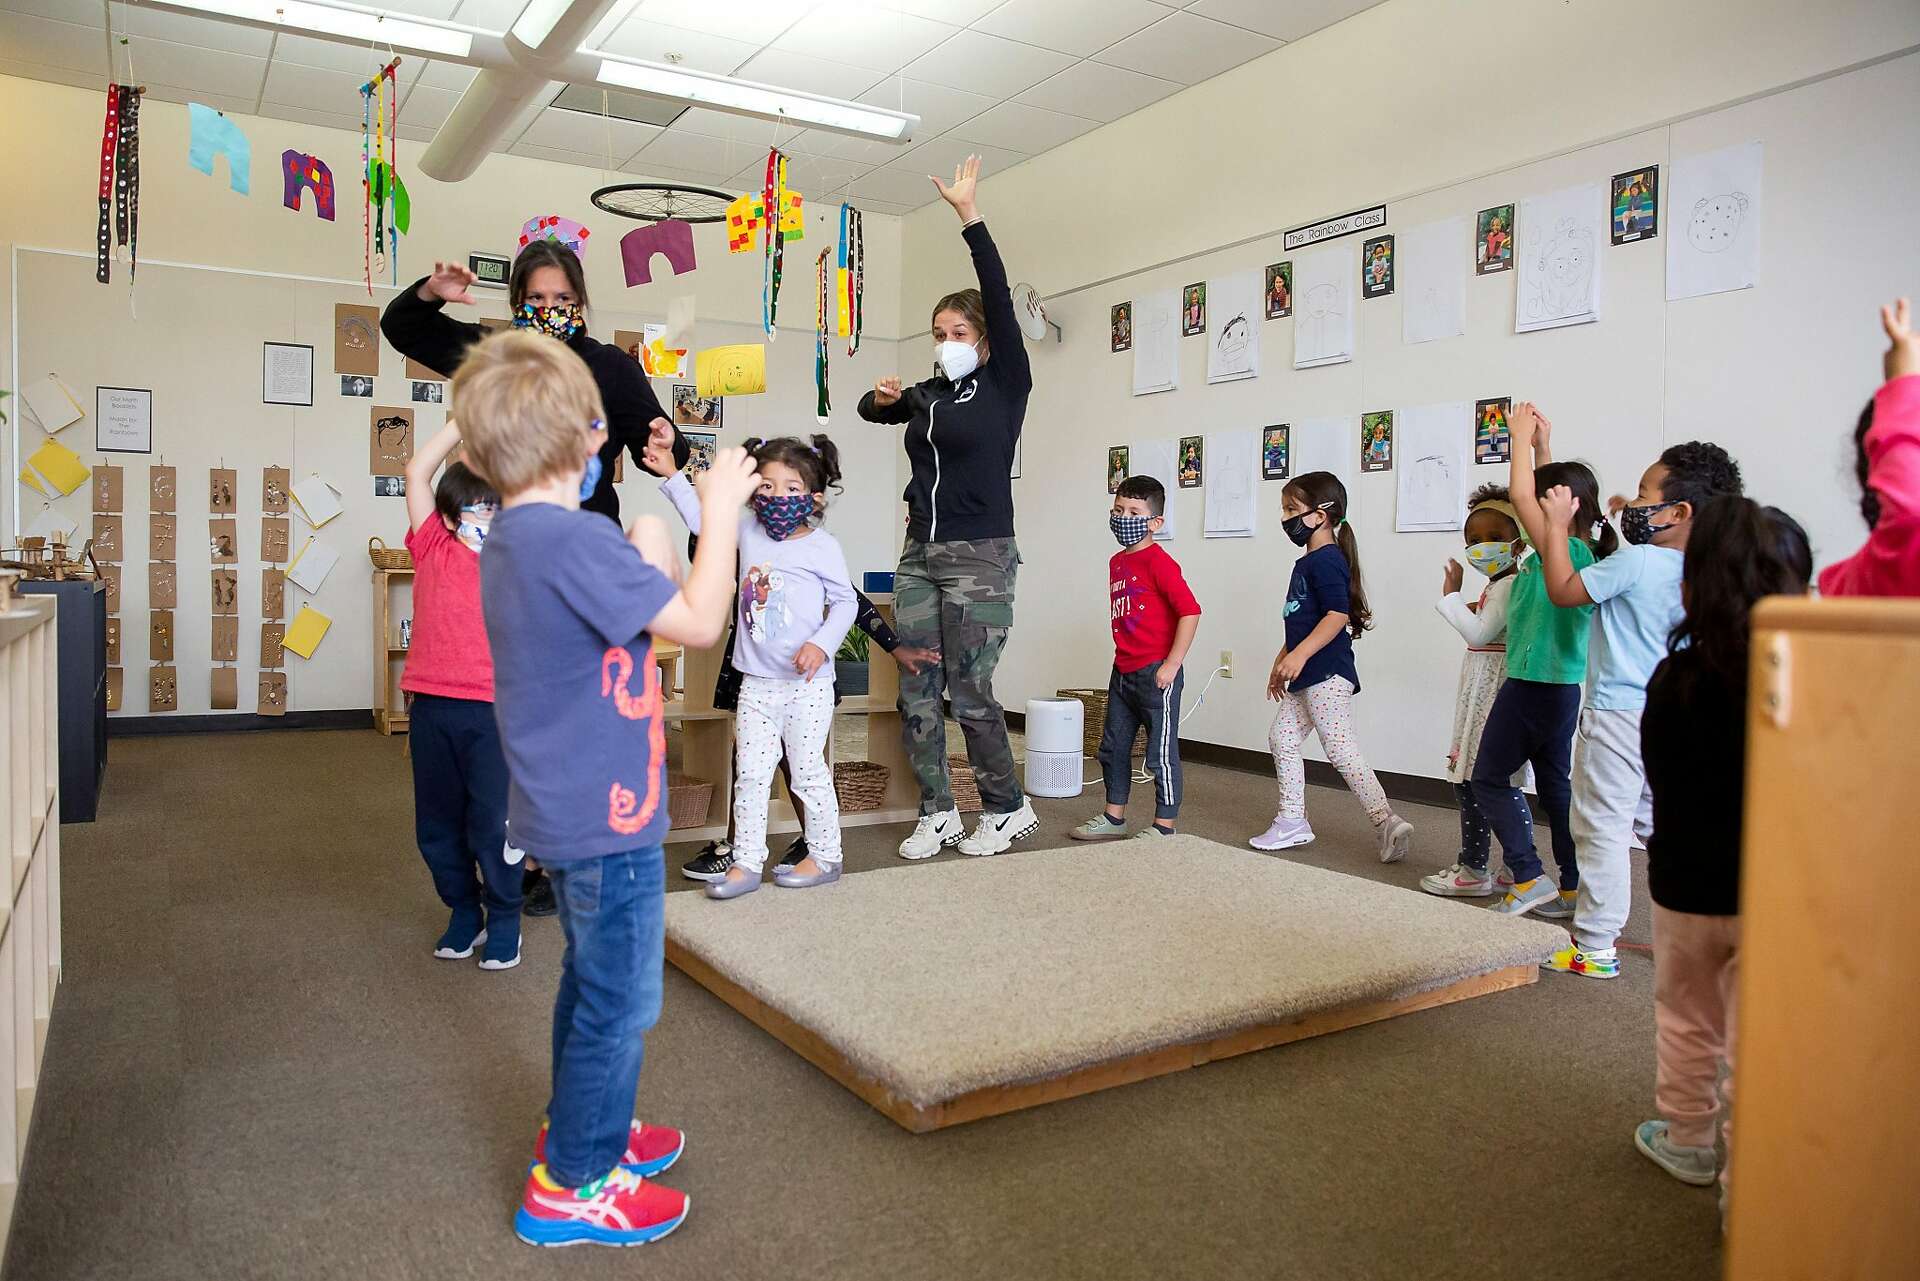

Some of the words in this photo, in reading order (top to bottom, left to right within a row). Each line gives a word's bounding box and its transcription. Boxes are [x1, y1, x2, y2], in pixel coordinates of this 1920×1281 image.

[1288, 233, 1304, 245] The
[1308, 221, 1349, 240] Rainbow
[1354, 213, 1380, 227] Class
